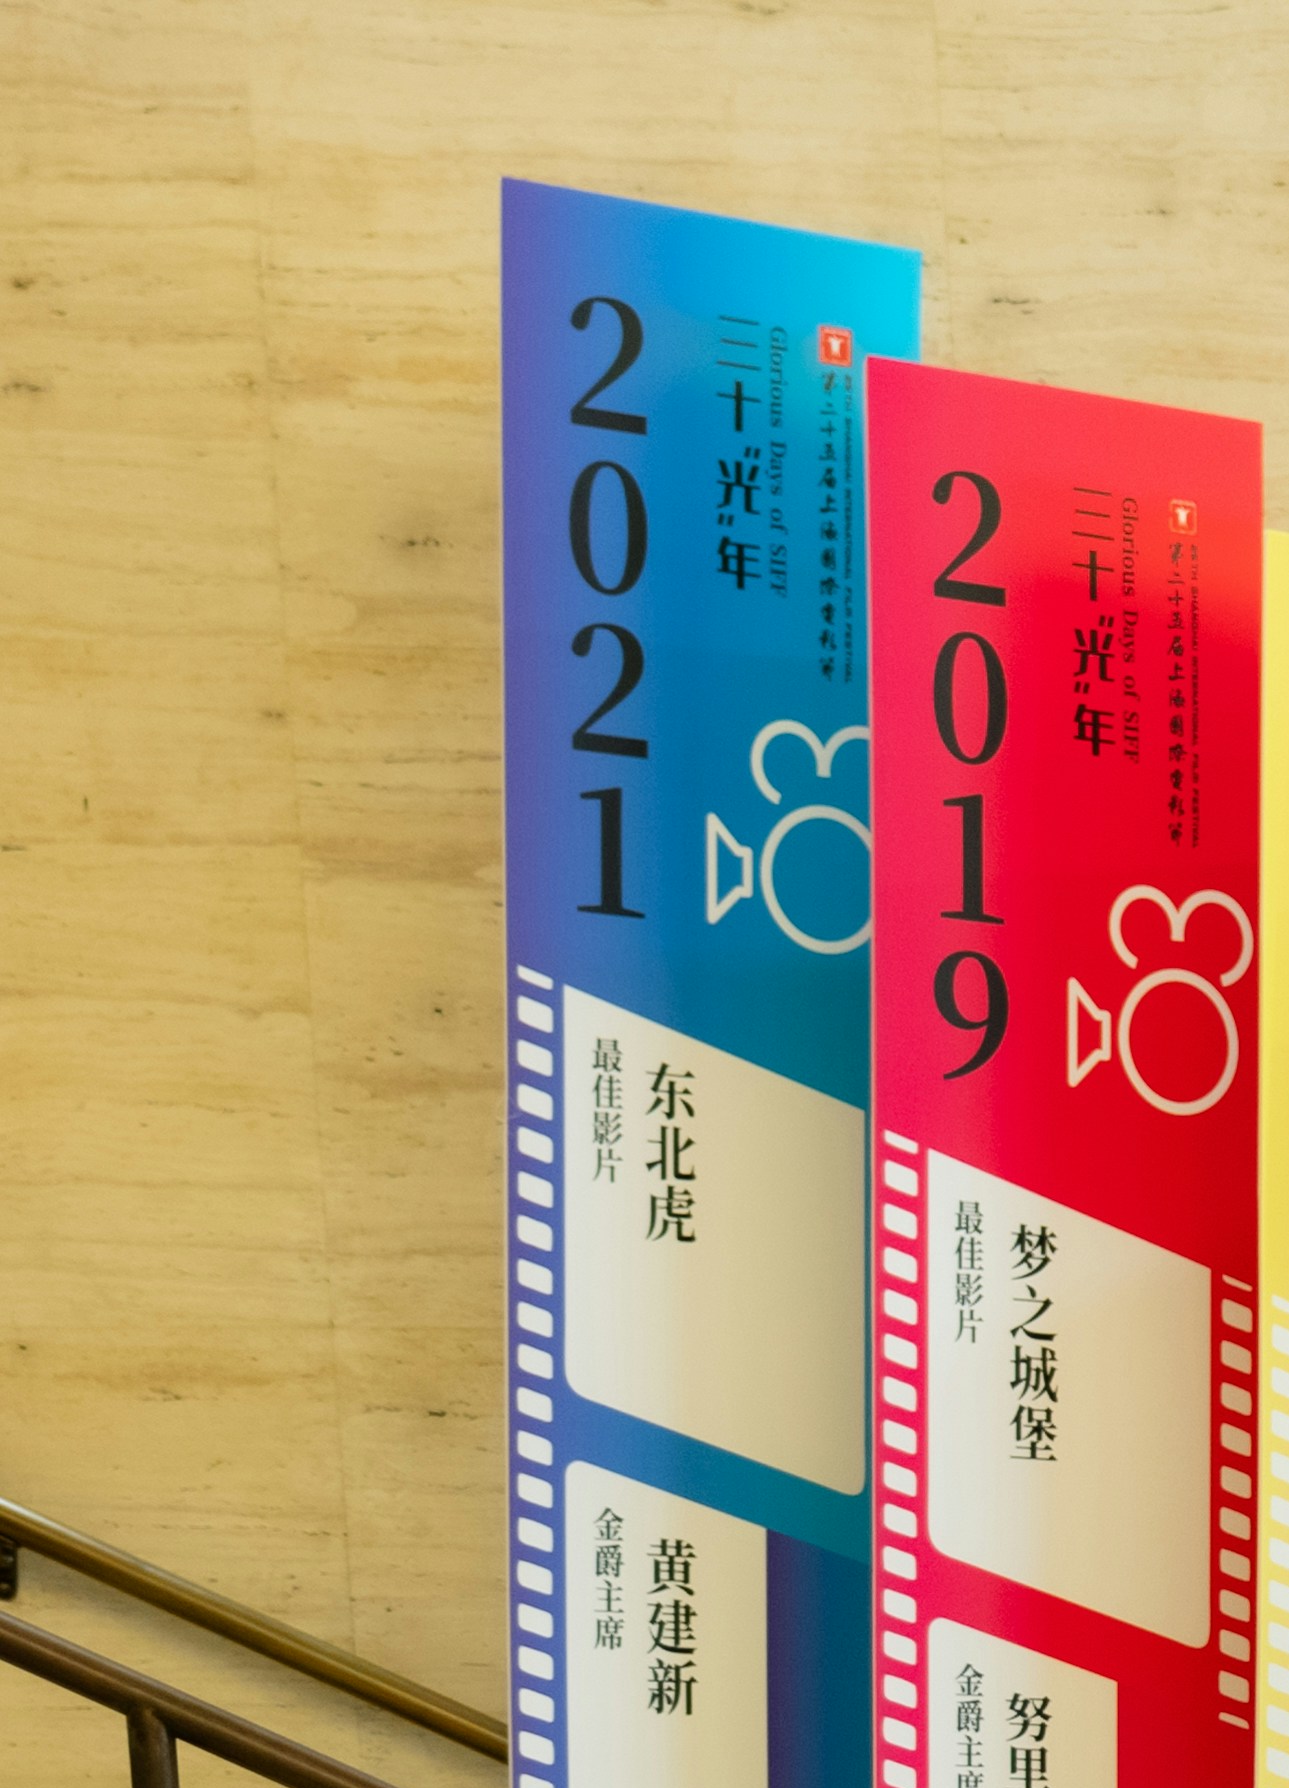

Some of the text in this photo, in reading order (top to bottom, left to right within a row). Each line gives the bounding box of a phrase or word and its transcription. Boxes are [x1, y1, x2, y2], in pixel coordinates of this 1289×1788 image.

[766, 327, 788, 598] Glorious Days of SIFF
[568, 295, 649, 920] 2021
[1118, 498, 1140, 764] Glorious Days of SIFF
[932, 470, 1008, 1081] 2019
[591, 1038, 623, 1183] 最佳影片
[645, 1062, 696, 1243] 东北虎
[954, 1200, 984, 1344] 最佳影片
[1009, 1223, 1059, 1461] 梦之城堡
[593, 1507, 624, 1651] 金爵主席
[647, 1537, 698, 1716] 黄建新
